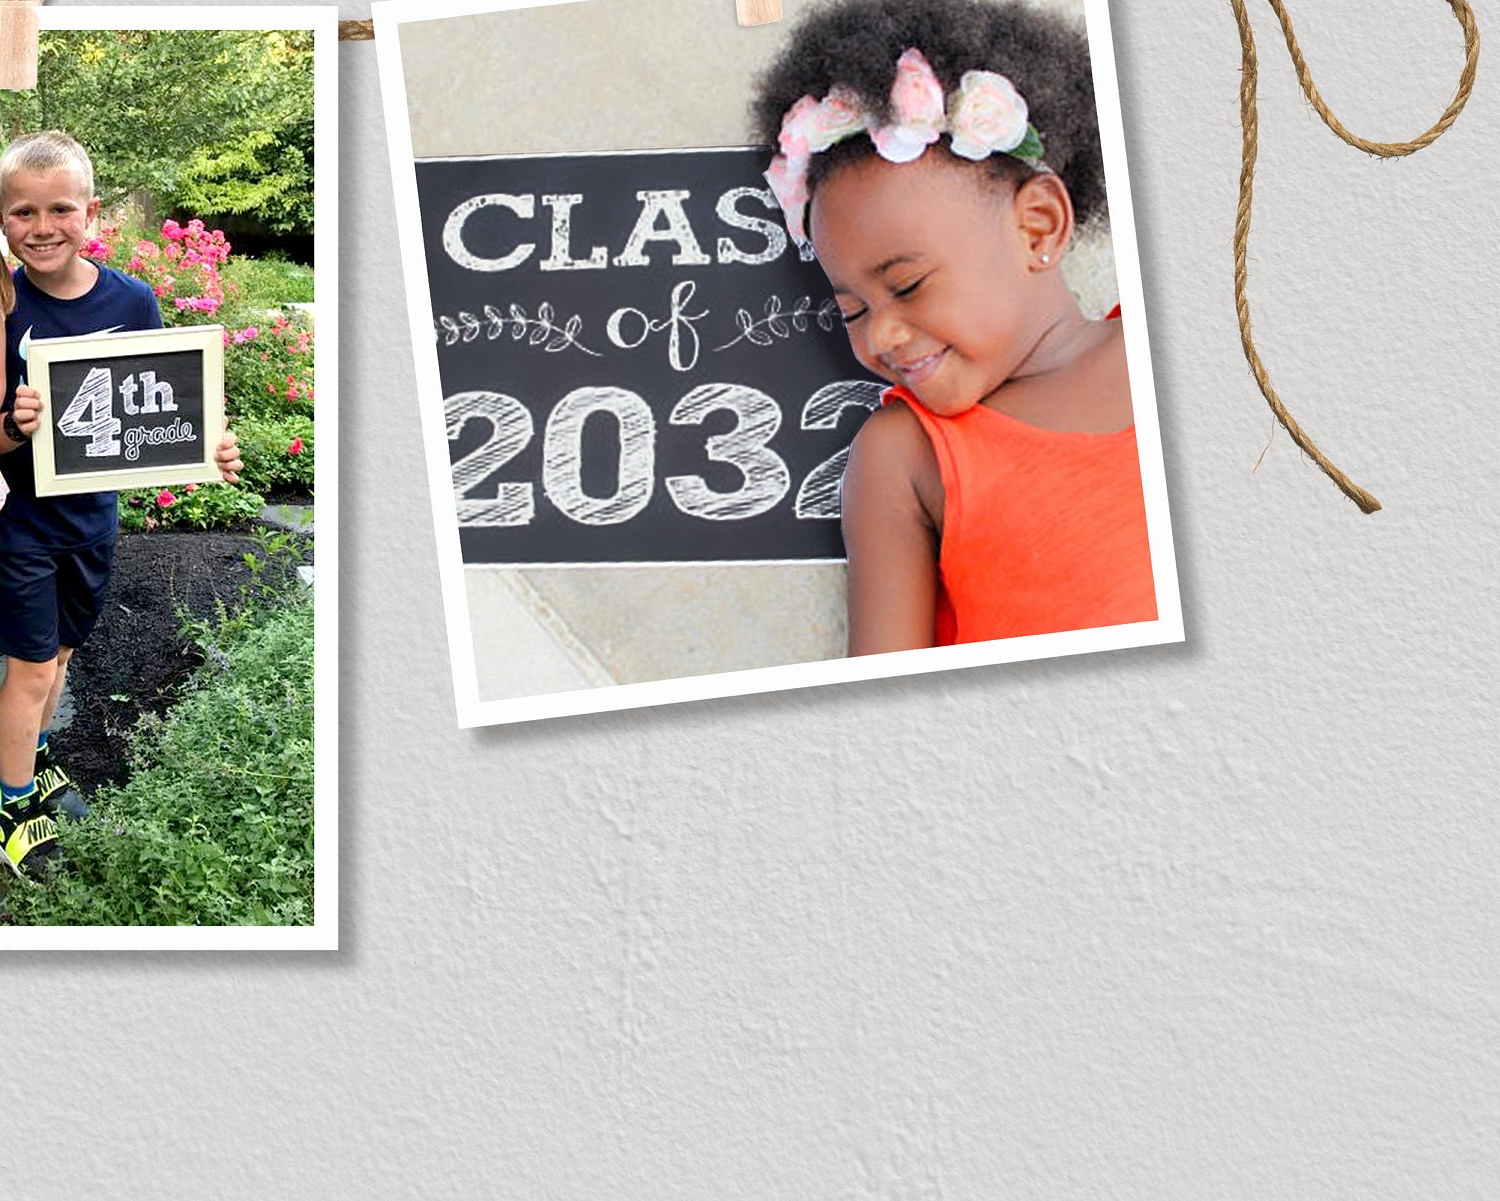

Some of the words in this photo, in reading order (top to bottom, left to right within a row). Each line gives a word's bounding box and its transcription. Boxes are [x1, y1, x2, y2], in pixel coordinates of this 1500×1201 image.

[442, 186, 814, 272] CLAS
[606, 280, 710, 371] of
[57, 367, 178, 457] 4th
[124, 417, 197, 461] grade
[26, 819, 57, 845] NIK
